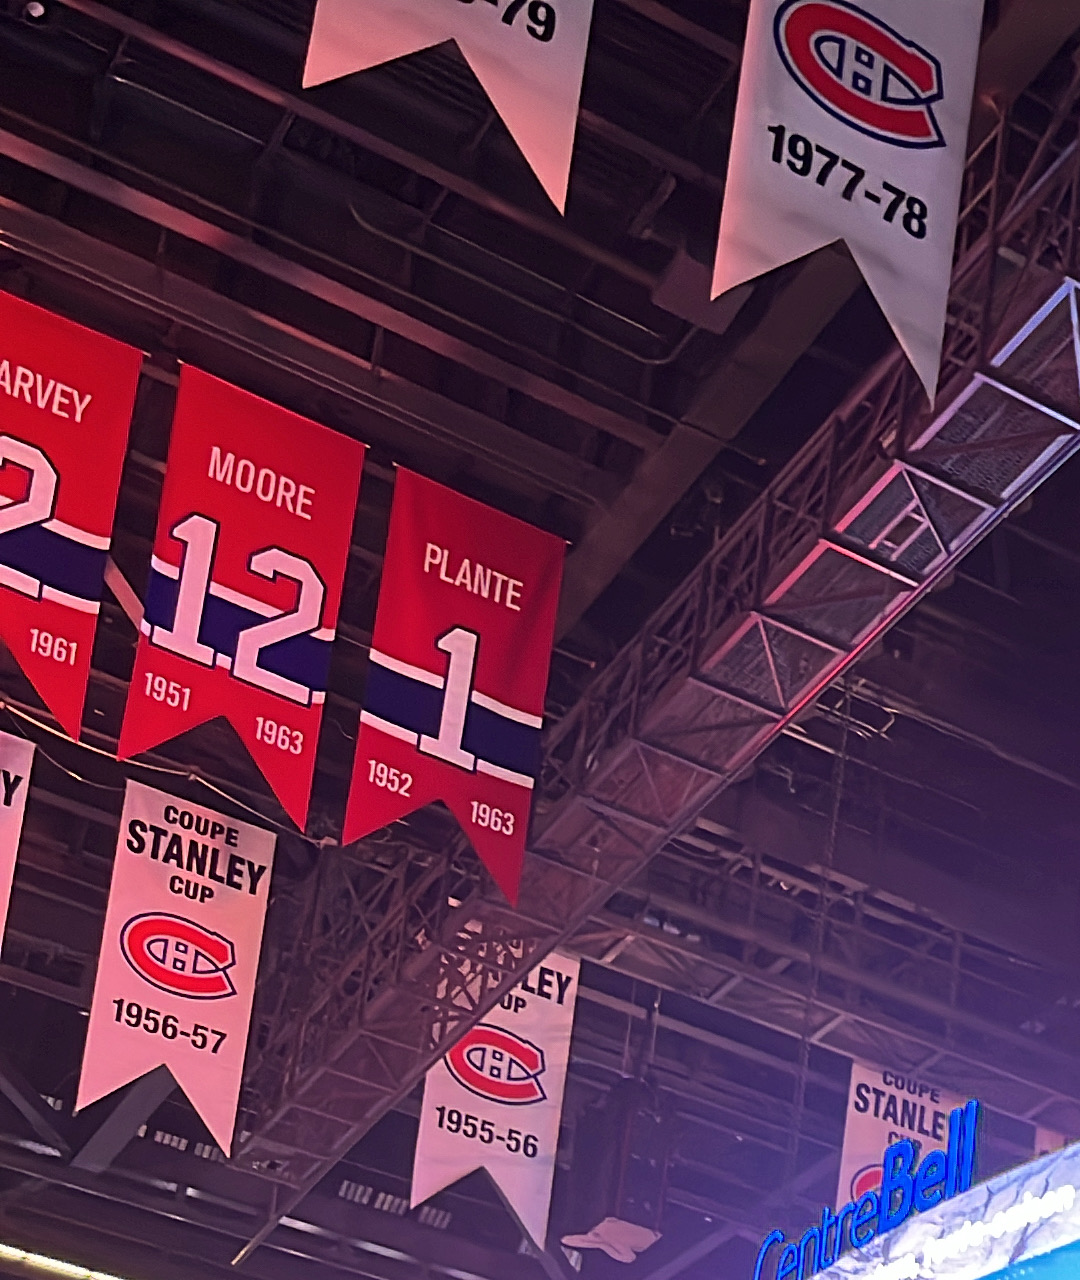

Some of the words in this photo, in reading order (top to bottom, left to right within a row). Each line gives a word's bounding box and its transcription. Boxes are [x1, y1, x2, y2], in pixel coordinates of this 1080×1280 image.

[767, 125, 928, 239] 1977-78
[0, 359, 92, 423] ARVEY
[207, 445, 316, 520] MOORE
[423, 542, 524, 612] PLANTE
[151, 513, 326, 707] 12
[29, 627, 78, 666] 1961
[143, 672, 192, 711] 1951
[418, 625, 479, 772] 1
[254, 716, 305, 754] 1963
[367, 759, 413, 798] 1952
[163, 805, 239, 847] COUPE
[470, 800, 515, 837] 1963
[126, 819, 267, 896] STANLEY
[169, 874, 215, 904] CUP
[112, 998, 228, 1054] 1956-57
[854, 1083, 946, 1141] STANLE
[882, 1070, 941, 1104] COUPE
[435, 1105, 539, 1159] 1955-56
